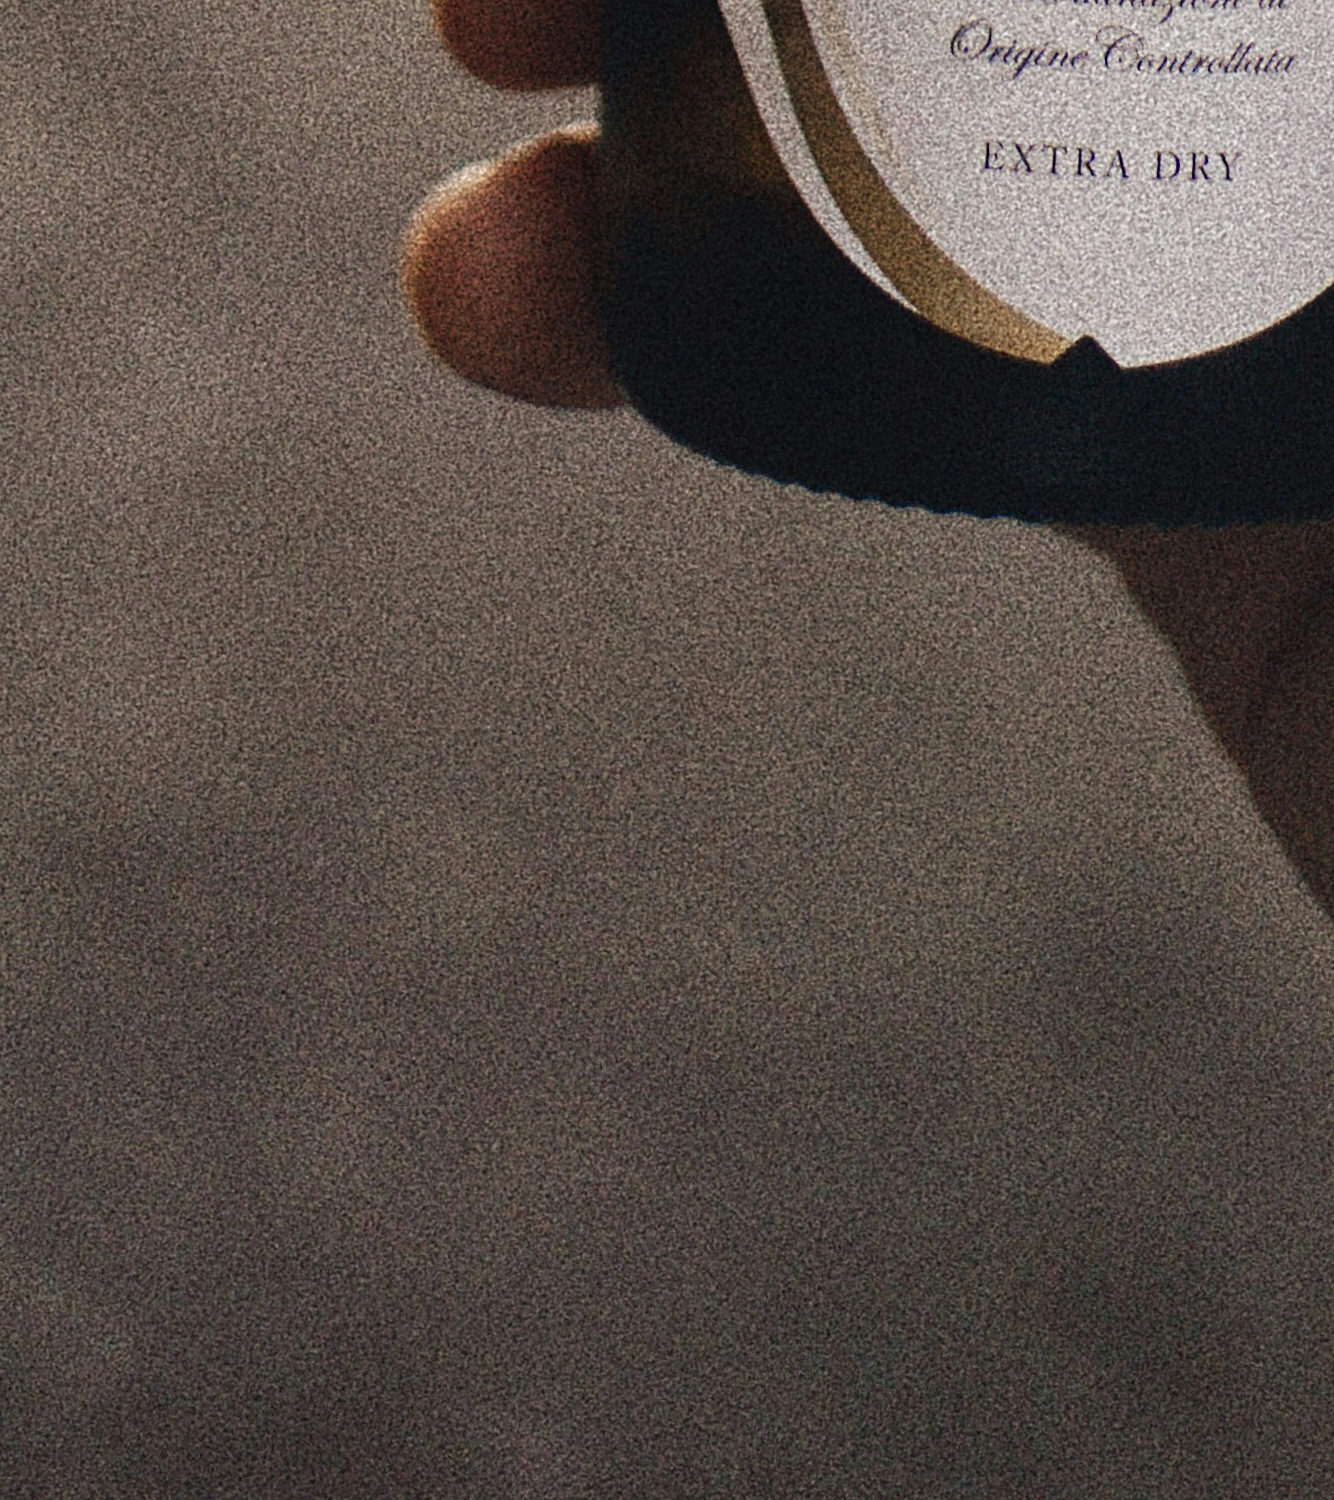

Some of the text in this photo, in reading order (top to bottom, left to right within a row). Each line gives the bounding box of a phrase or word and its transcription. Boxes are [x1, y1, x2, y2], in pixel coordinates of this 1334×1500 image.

[948, 21, 1297, 81] Origine Controllata
[982, 140, 1244, 184] EXTRA DRY
